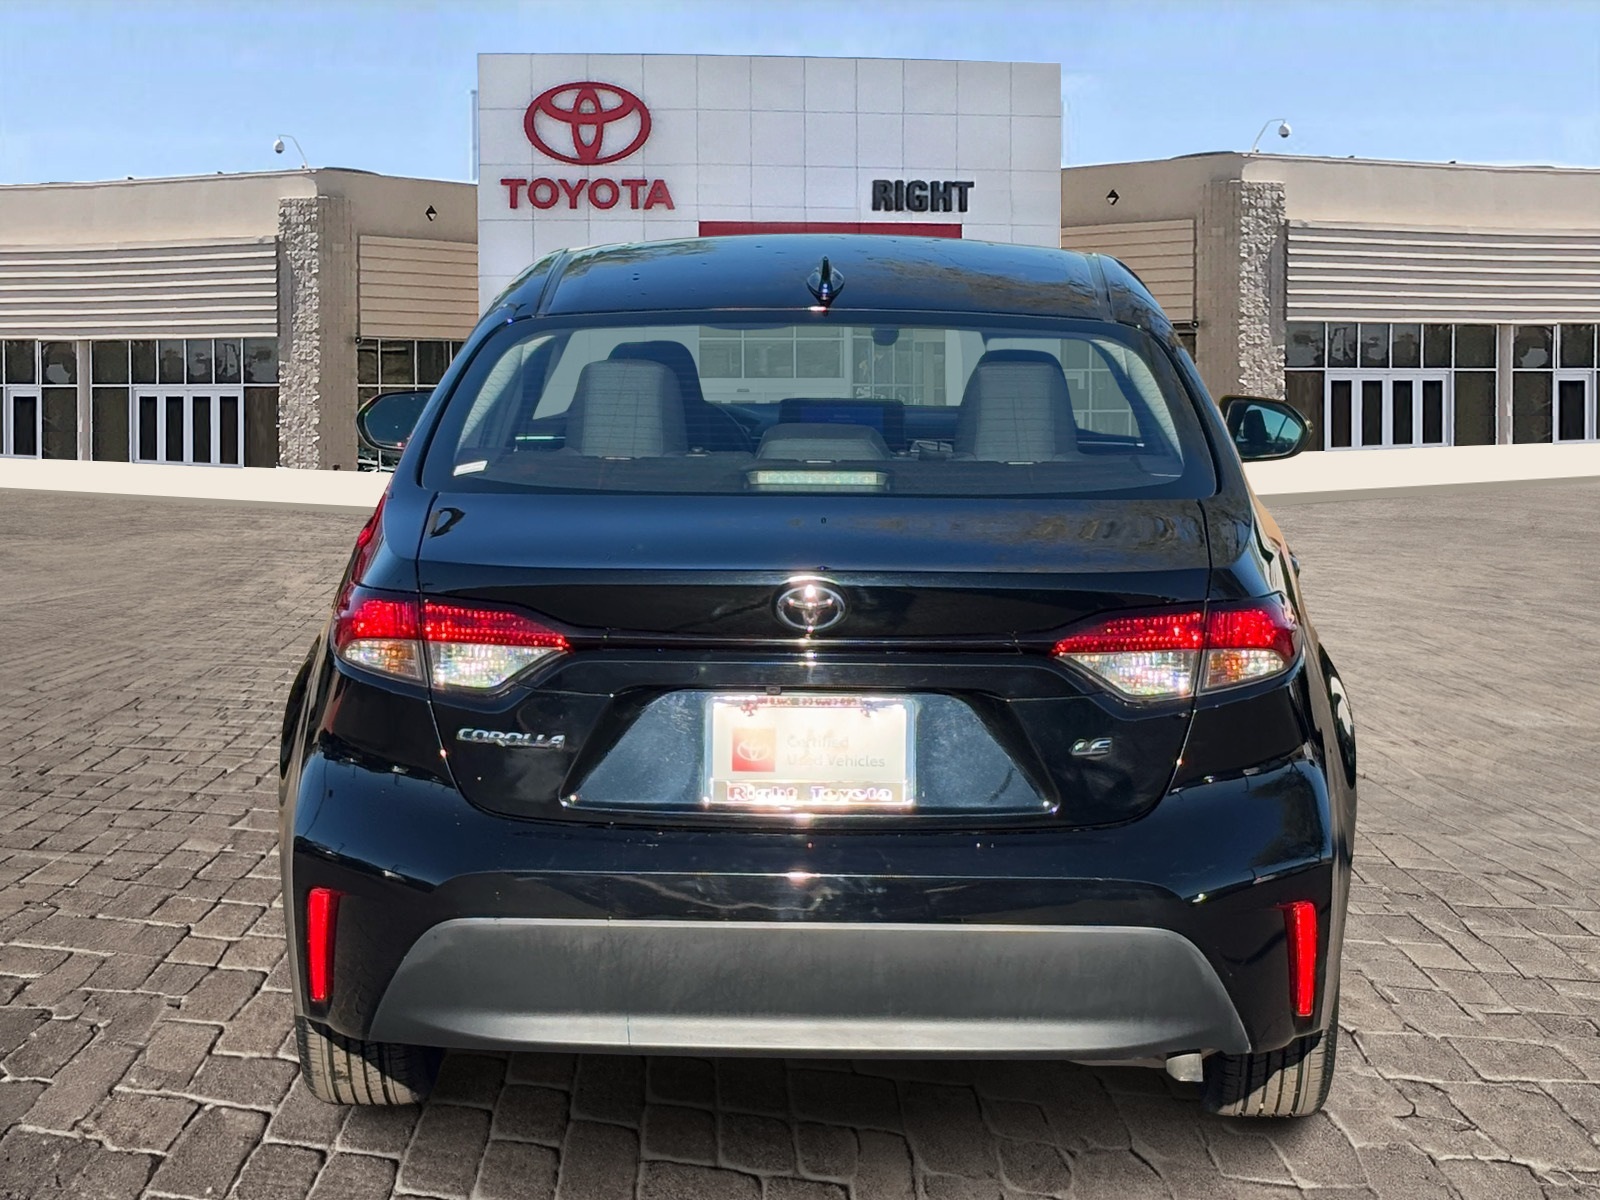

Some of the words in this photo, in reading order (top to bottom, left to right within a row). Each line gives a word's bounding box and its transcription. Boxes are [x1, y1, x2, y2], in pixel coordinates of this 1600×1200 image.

[500, 178, 675, 210] TOYOTA
[872, 180, 975, 212] RIGHT
[456, 728, 565, 748] COROLLA
[1069, 738, 1112, 756] LE
[787, 753, 823, 768] Ud
[828, 754, 886, 768] Vehicles
[728, 784, 798, 800] Right
[810, 786, 893, 801] Toyota
